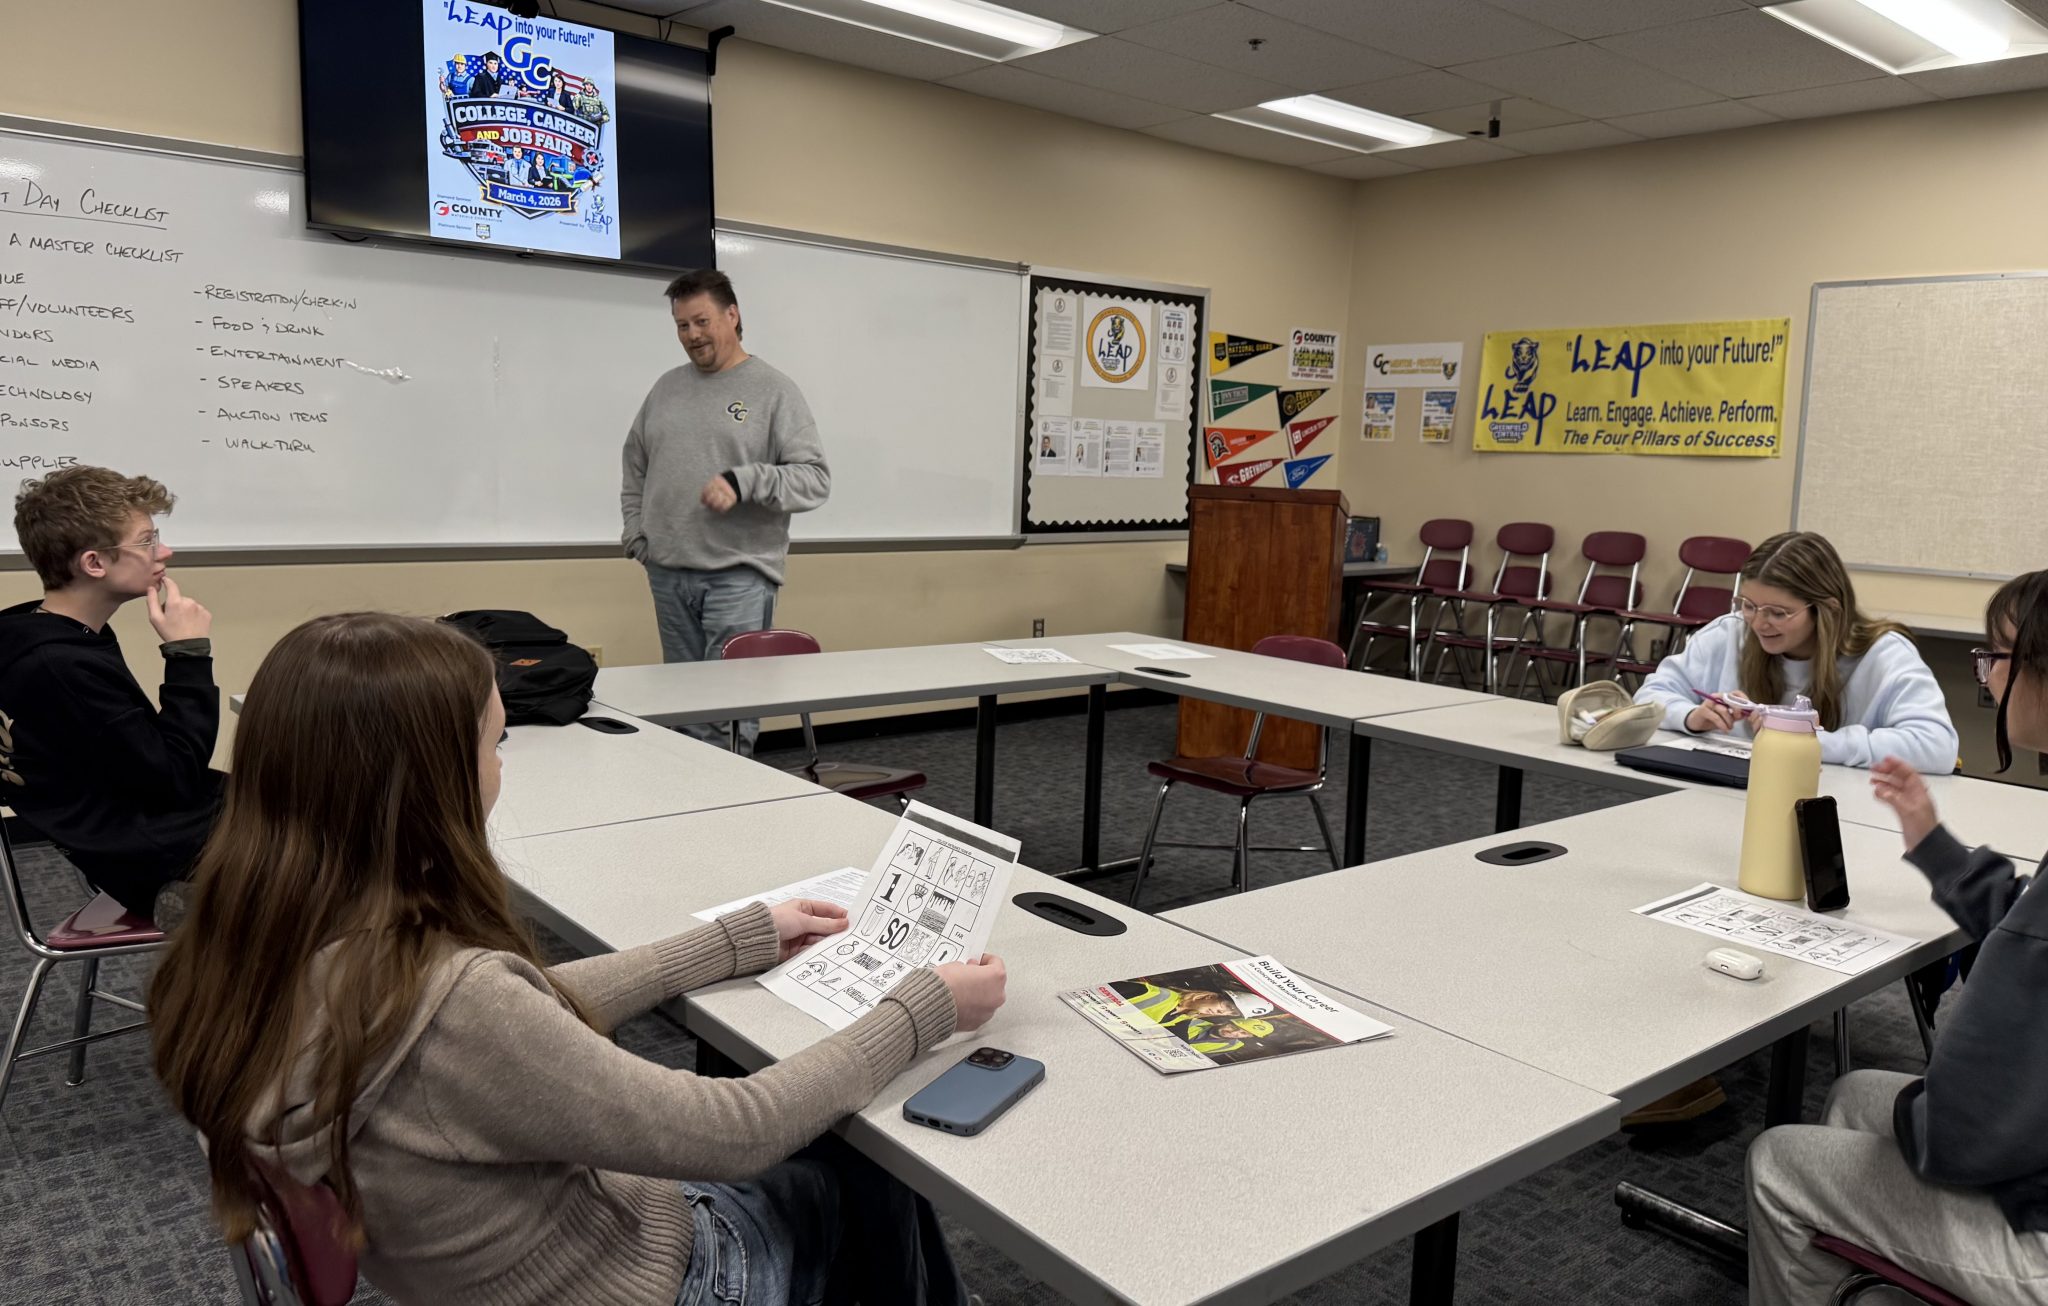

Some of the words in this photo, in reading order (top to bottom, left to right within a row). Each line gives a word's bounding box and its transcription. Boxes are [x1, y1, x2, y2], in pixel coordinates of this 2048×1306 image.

[515, 18, 533, 35] into
[535, 25, 556, 41] your
[503, 36, 552, 89] GC
[455, 105, 531, 125] COLLEGE,
[532, 111, 595, 145] CAREER
[476, 130, 500, 140] AND
[500, 127, 532, 145] JOB
[534, 131, 574, 157] FAIR
[498, 188, 527, 202] March
[528, 195, 537, 206] 4,
[539, 195, 561, 207] 2026
[451, 202, 502, 218] COUNTY
[9, 232, 21, 247] A
[29, 236, 94, 255] MASTER
[105, 241, 184, 263] CHECKLIST
[212, 316, 254, 331] FOOD
[275, 323, 324, 336] DRINK
[1304, 333, 1336, 344] COUNTY
[51, 358, 100, 371] MEDIA
[210, 345, 345, 368] ENTERTAINMENT
[1660, 339, 1684, 366] into
[1687, 341, 1719, 372] your
[217, 376, 305, 395] SPEAKERS
[289, 412, 328, 423] ITEMS
[727, 401, 748, 422] GC
[1566, 401, 1602, 423] Learn.
[1606, 401, 1656, 428] Engage.
[1659, 400, 1714, 423] Achieve.
[1717, 400, 1777, 423] Perform.
[1563, 430, 1589, 445] The
[1592, 430, 1630, 446] Four
[1631, 430, 1681, 447] Pillars
[1683, 430, 1703, 447] of
[1703, 431, 1775, 448] Success
[878, 917, 910, 950] SO
[955, 931, 964, 940] FAR
[1258, 960, 1287, 980] Build
[1283, 978, 1307, 996] Your
[1304, 994, 1339, 1013] Career
